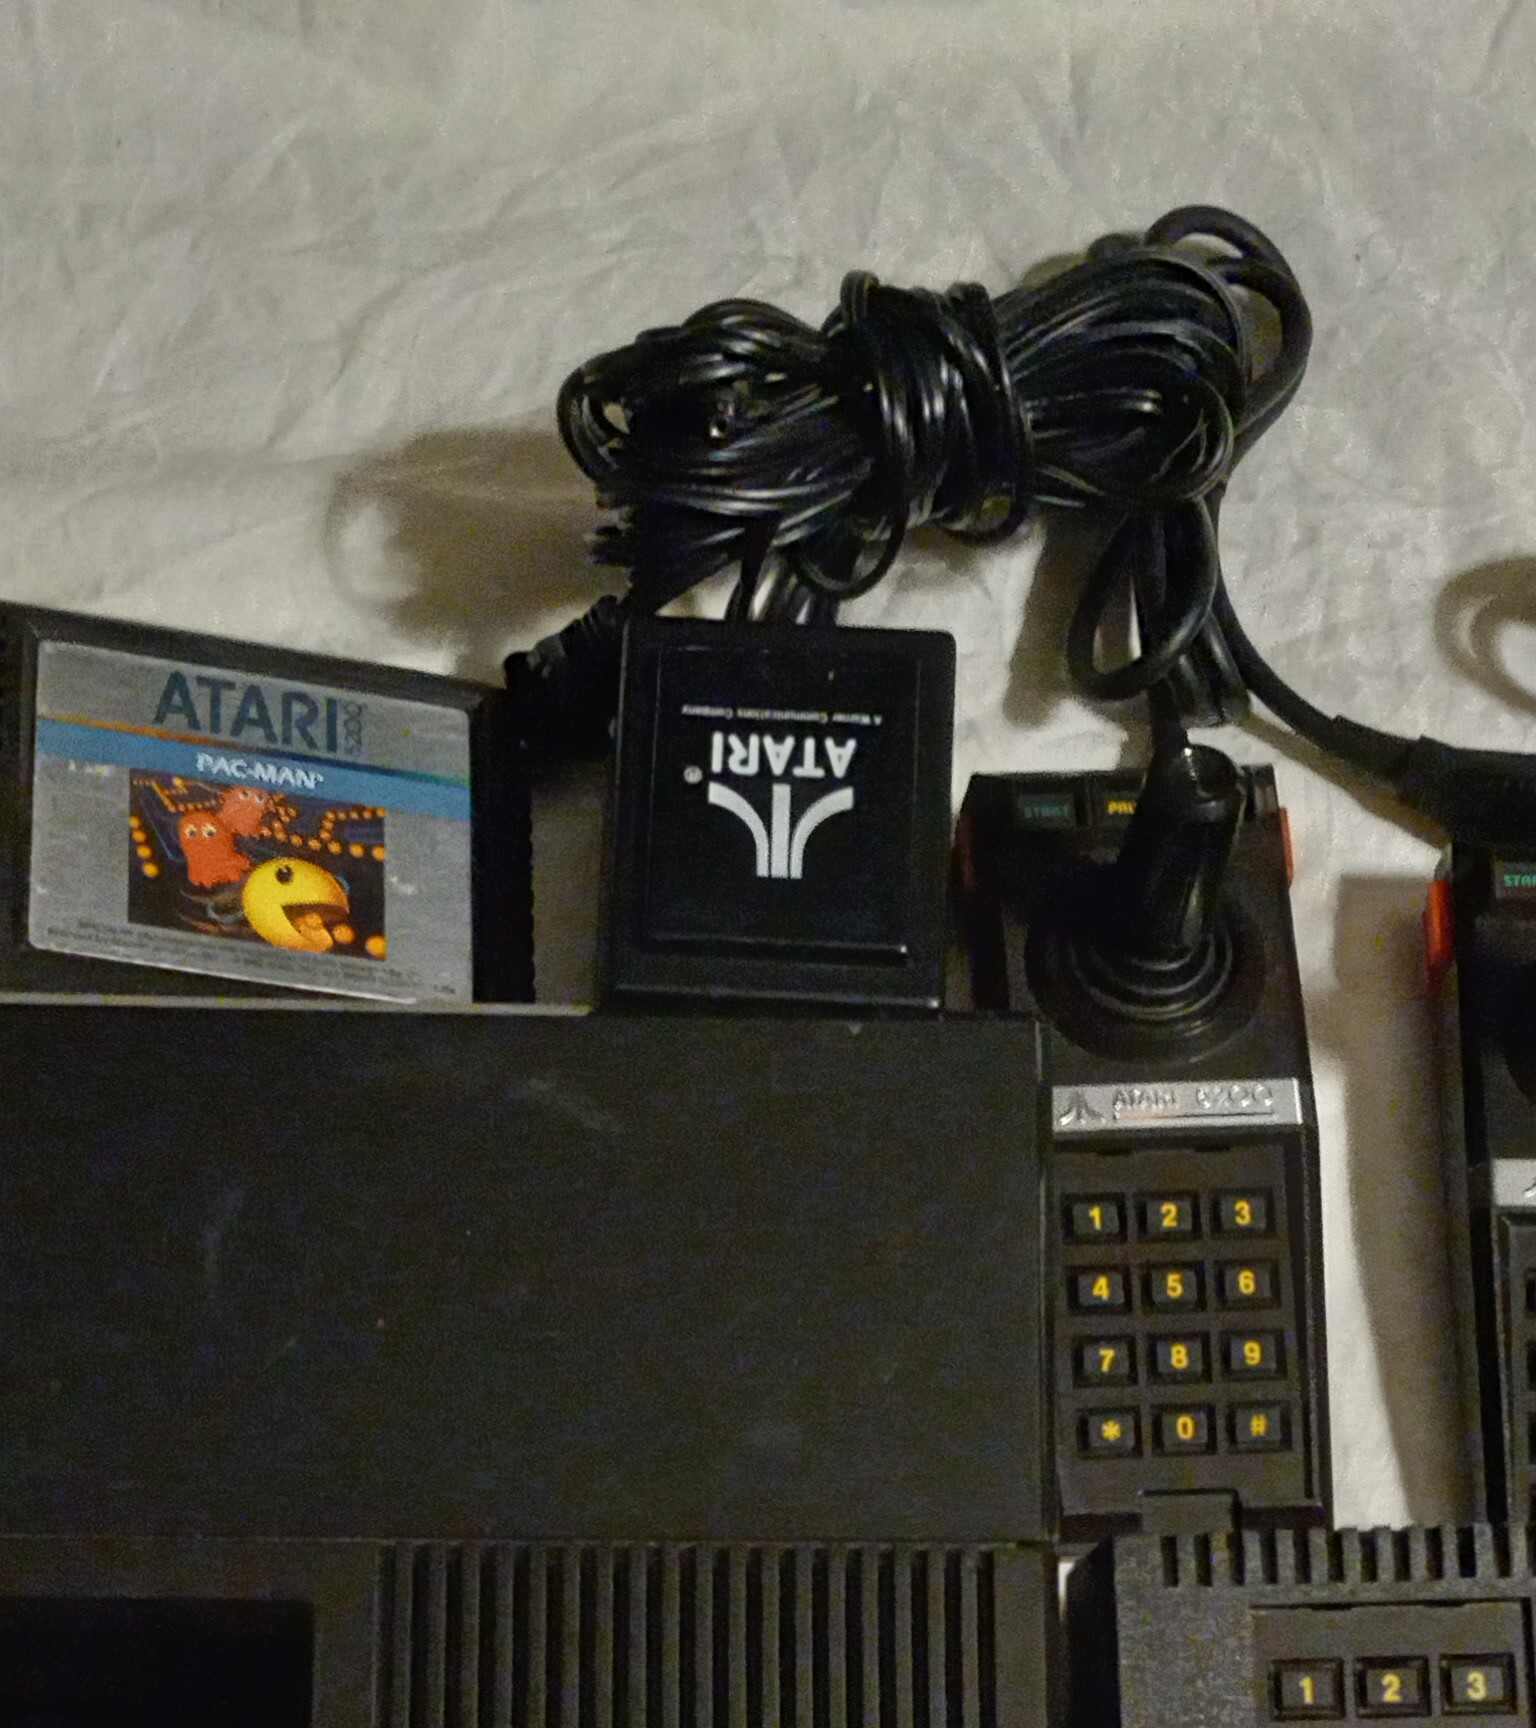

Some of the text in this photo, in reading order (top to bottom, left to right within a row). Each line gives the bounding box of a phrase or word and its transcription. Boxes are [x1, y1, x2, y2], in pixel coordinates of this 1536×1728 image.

[154, 670, 338, 753] ATARI
[682, 704, 733, 719] Company
[737, 707, 828, 723] Communications
[711, 731, 857, 779] ATARI
[195, 752, 317, 790] PAC-MAN
[1089, 1198, 1253, 1229] 1 2 3
[1092, 1268, 1256, 1299] 4 5 6
[1099, 1340, 1262, 1372] 7 8 9
[1175, 1414, 1196, 1440] 0
[1300, 1670, 1488, 1703] 1 2 3
